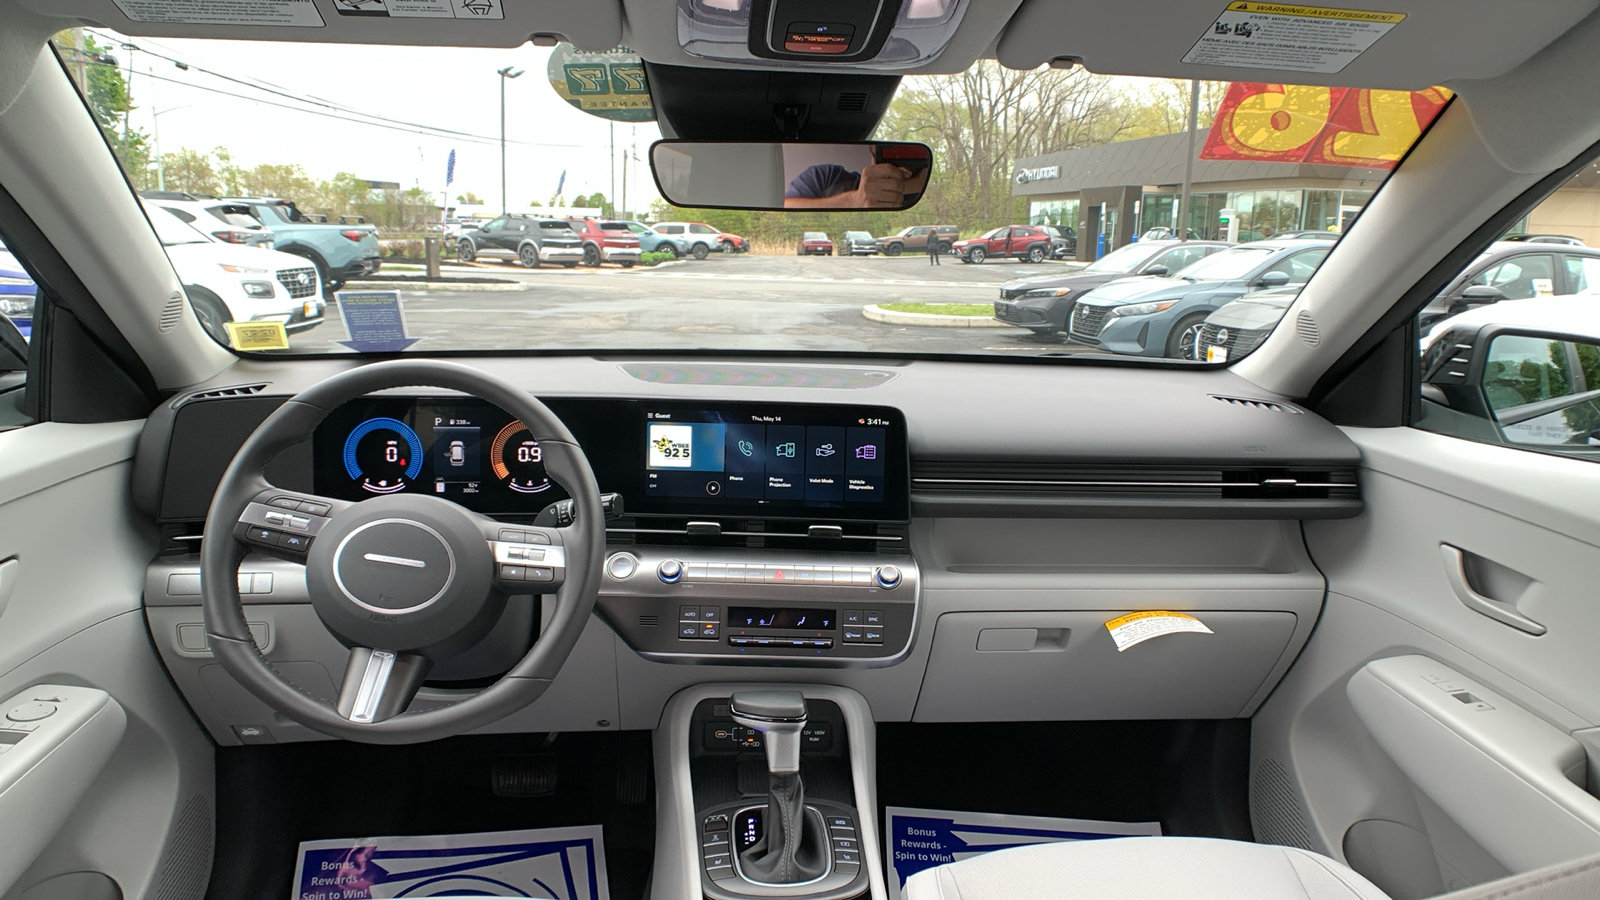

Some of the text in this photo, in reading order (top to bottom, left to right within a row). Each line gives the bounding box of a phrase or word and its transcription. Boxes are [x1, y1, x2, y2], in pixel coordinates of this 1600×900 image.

[1028, 166, 1059, 181] HYUNDAI
[434, 417, 442, 426] P
[866, 418, 882, 426] 3:41
[386, 446, 398, 462] 0
[518, 446, 542, 463] 0.9
[369, 613, 398, 624] AIRBAG
[907, 827, 937, 837] Bonus
[901, 839, 942, 850] Rewards
[895, 851, 952, 863] Spin to Win!
[321, 861, 355, 871] Bonus
[311, 875, 358, 887] Rewards
[302, 889, 368, 900] Spin to Win!
